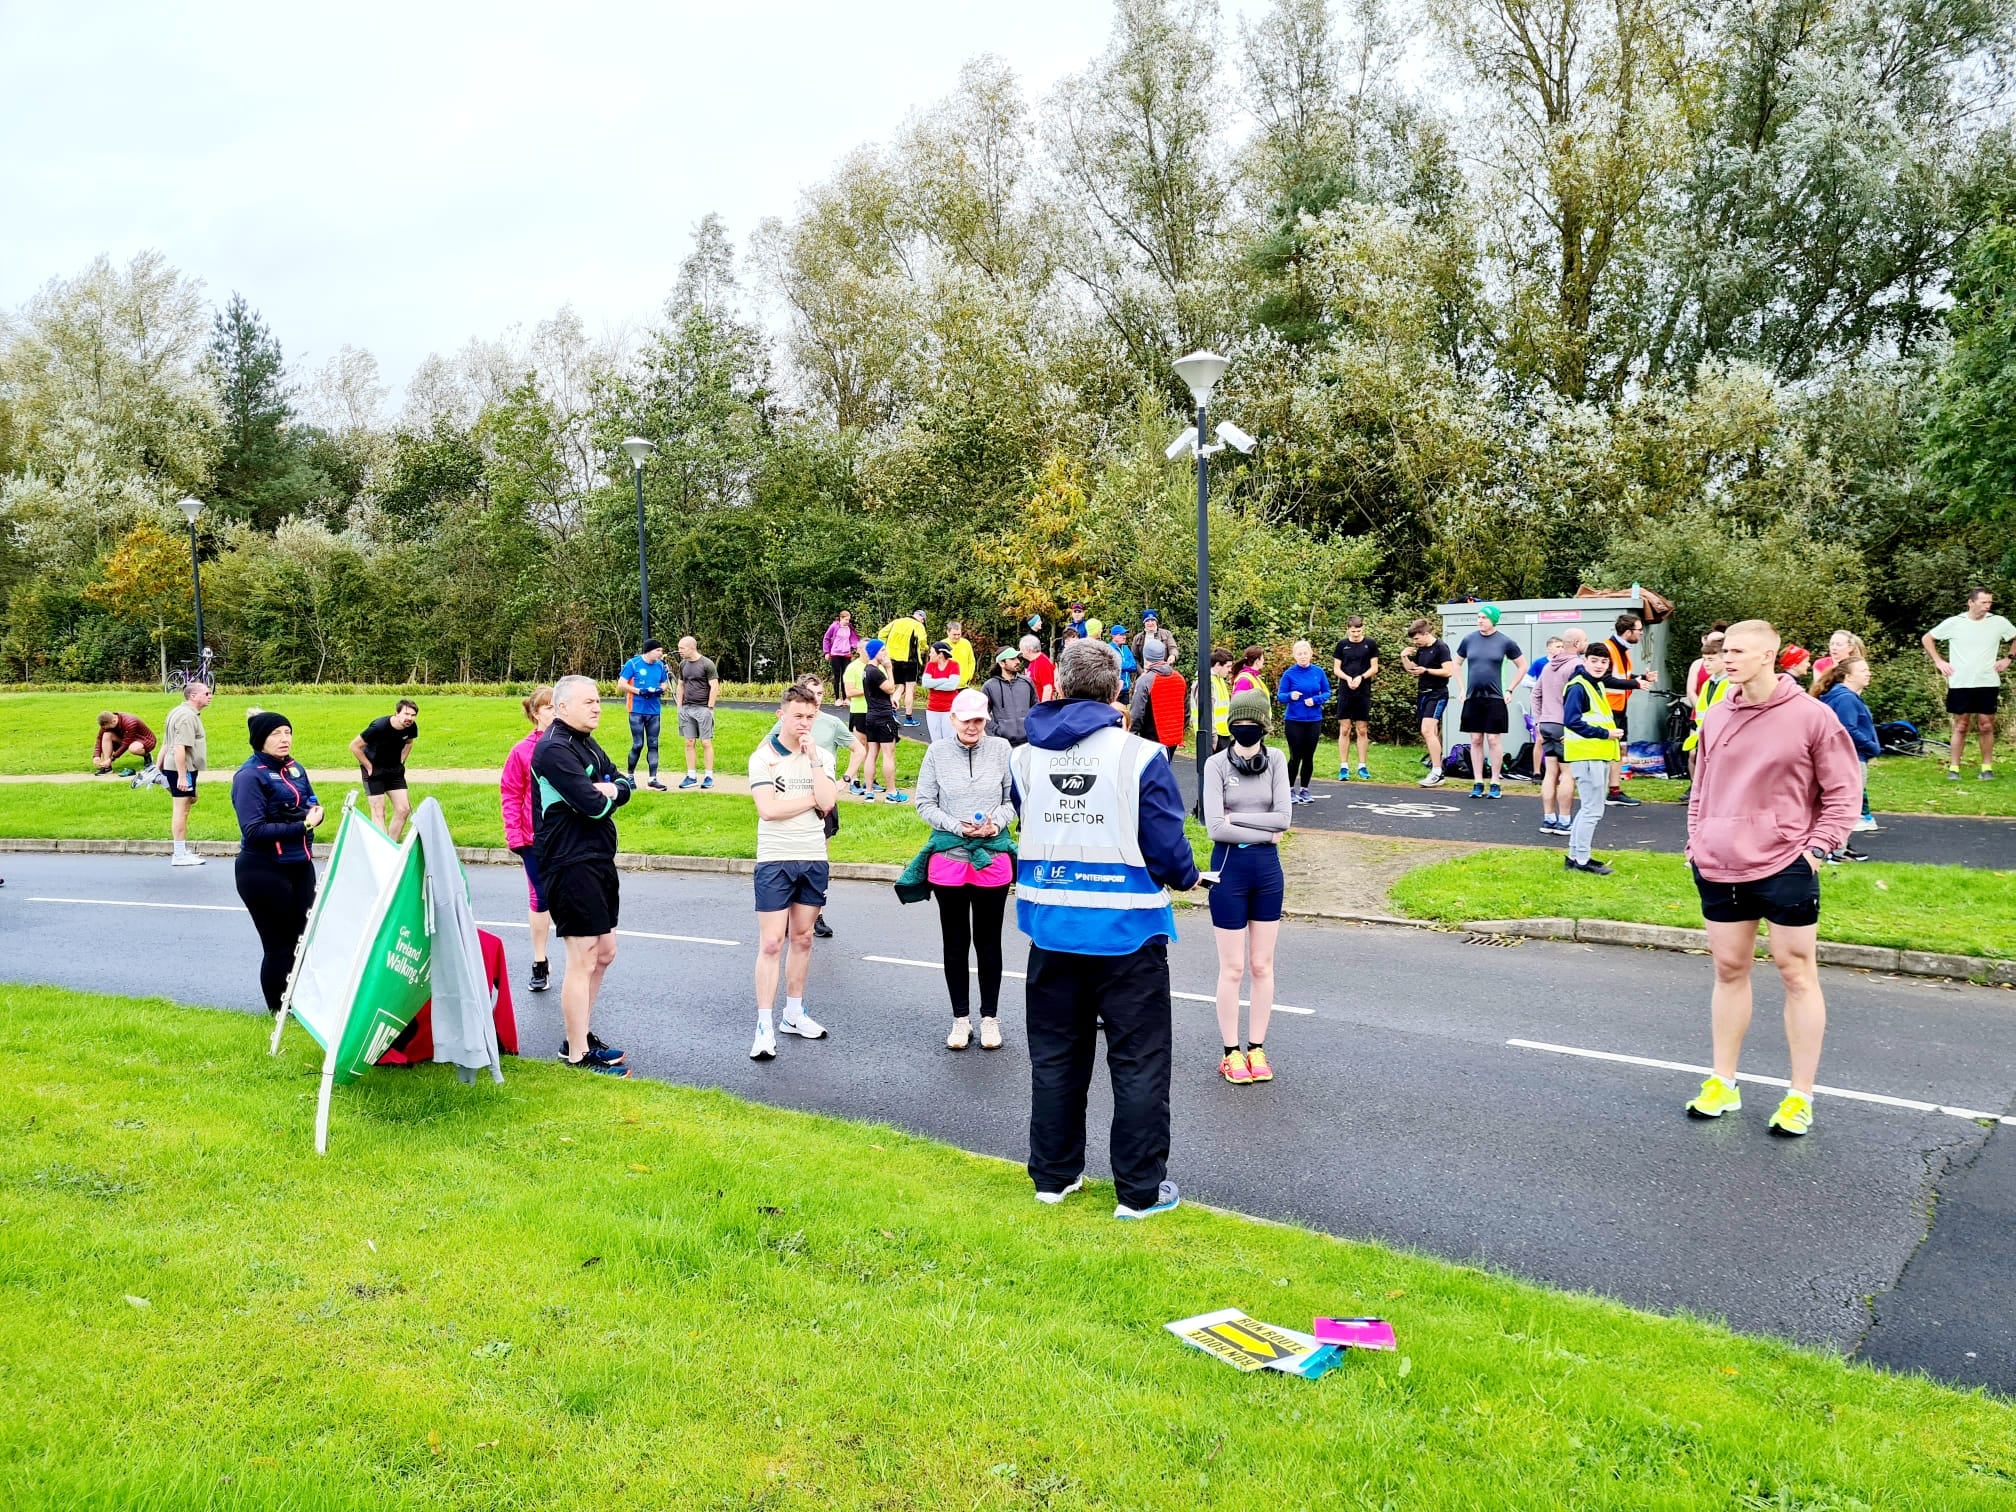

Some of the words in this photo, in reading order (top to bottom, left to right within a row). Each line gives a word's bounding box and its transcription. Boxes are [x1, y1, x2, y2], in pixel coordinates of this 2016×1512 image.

[1050, 751, 1099, 768] parkrun
[1059, 799, 1086, 810] RUN
[1044, 812, 1104, 824] DIRECTOR
[1082, 873, 1126, 883] INTERSPORT
[396, 937, 422, 961] Ireland
[386, 950, 419, 984] Walking
[1238, 1317, 1265, 1332] RUN
[1265, 1330, 1306, 1353] ROUTE
